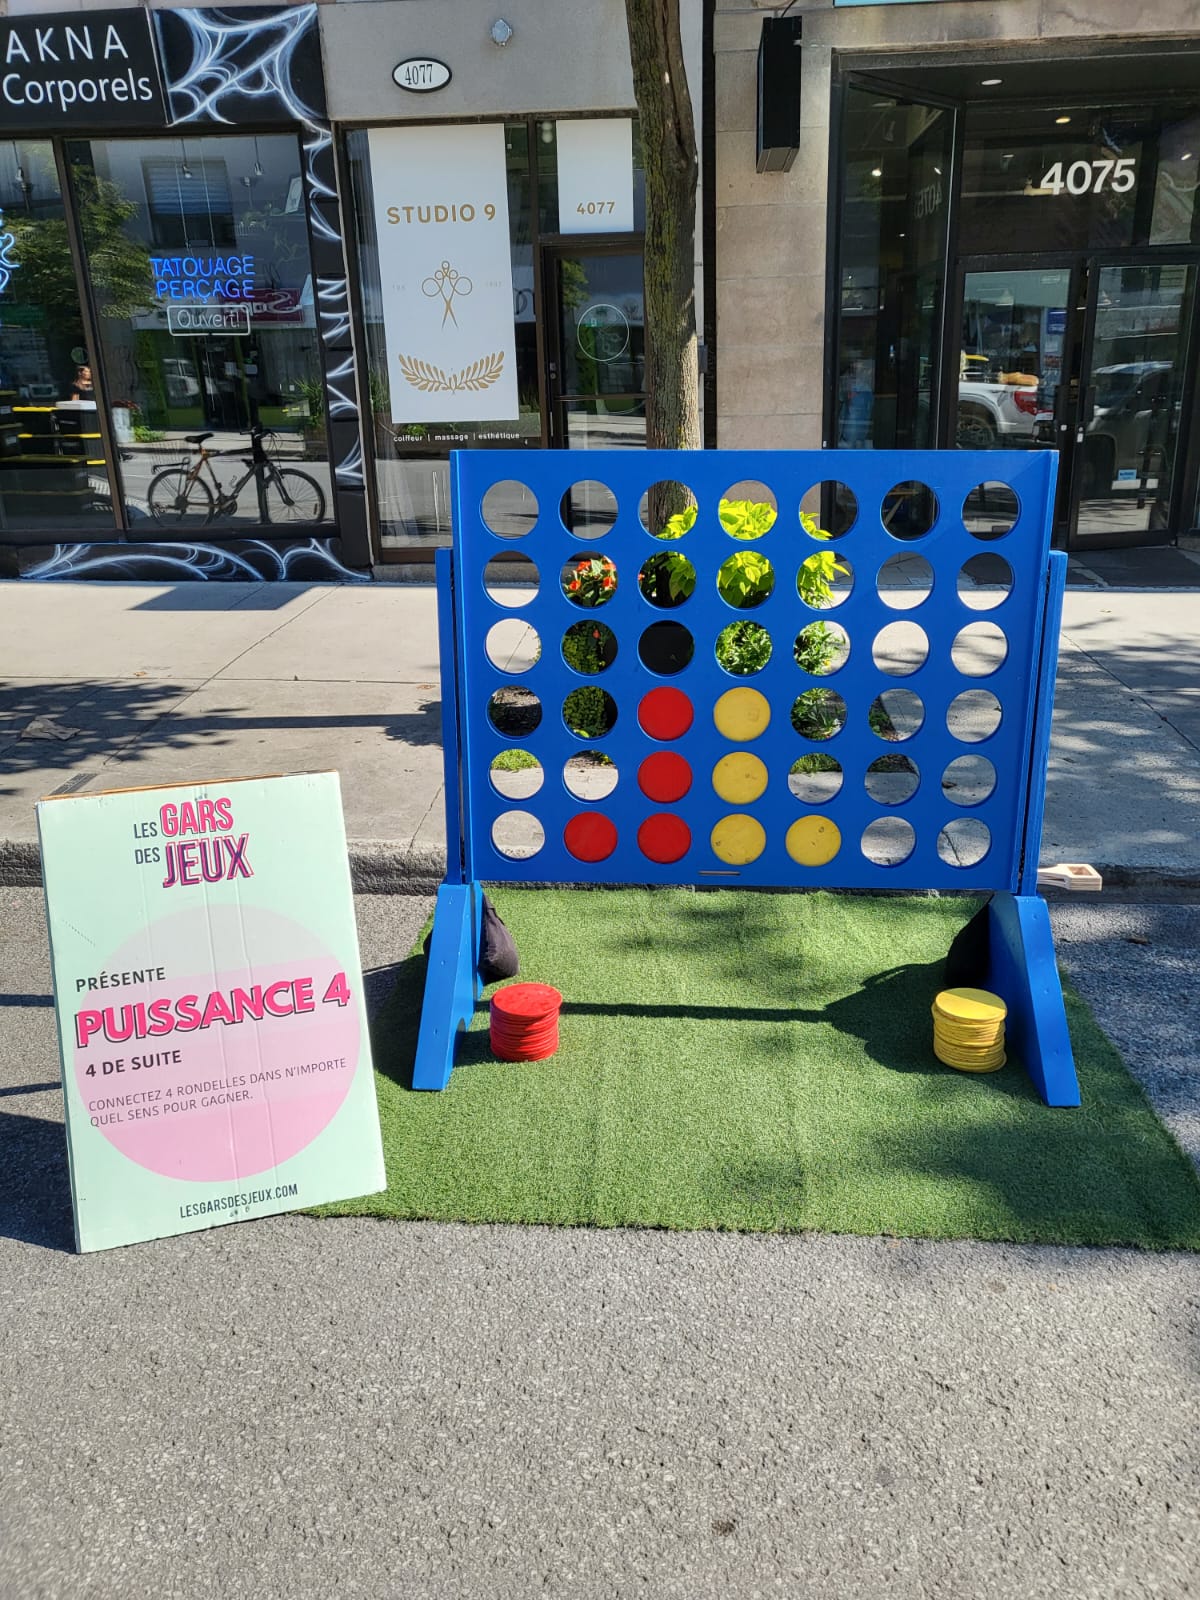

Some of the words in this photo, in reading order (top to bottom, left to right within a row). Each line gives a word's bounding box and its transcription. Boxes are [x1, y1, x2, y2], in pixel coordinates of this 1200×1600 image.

[5, 24, 128, 65] AKNA
[2, 67, 153, 111] Corporels
[404, 63, 434, 87] 4077
[1040, 158, 1137, 196] 4075
[386, 205, 475, 225] STUDIO
[484, 204, 496, 221] 9
[576, 201, 616, 216] 4077
[149, 255, 255, 277] TATOUAGE
[156, 278, 255, 303] PERÇAGE
[393, 434, 423, 443] coiffeur
[435, 433, 469, 442] massage
[134, 822, 158, 839] LES
[159, 797, 234, 838] GARS
[135, 848, 161, 865] DES
[163, 833, 253, 888] JEUX
[76, 966, 166, 992] PRÉSENTE
[74, 976, 315, 1048] PUISSANCE
[323, 972, 351, 1008] 4
[85, 1064, 96, 1078] 4
[102, 1058, 125, 1075] DE
[131, 1050, 182, 1071] SUITE
[89, 1088, 161, 1112] CONNECTEZ
[165, 1087, 173, 1099] 4
[177, 1075, 246, 1096] RONDELLES
[250, 1070, 281, 1084] DANS
[285, 1057, 347, 1080] N'IMPORTE
[90, 1113, 124, 1127] QUEL
[128, 1106, 159, 1122] SENS
[163, 1099, 198, 1116] POUR
[201, 1091, 253, 1111] GAGNER.
[179, 1184, 298, 1218] LESGARSDESJEUX.COM
